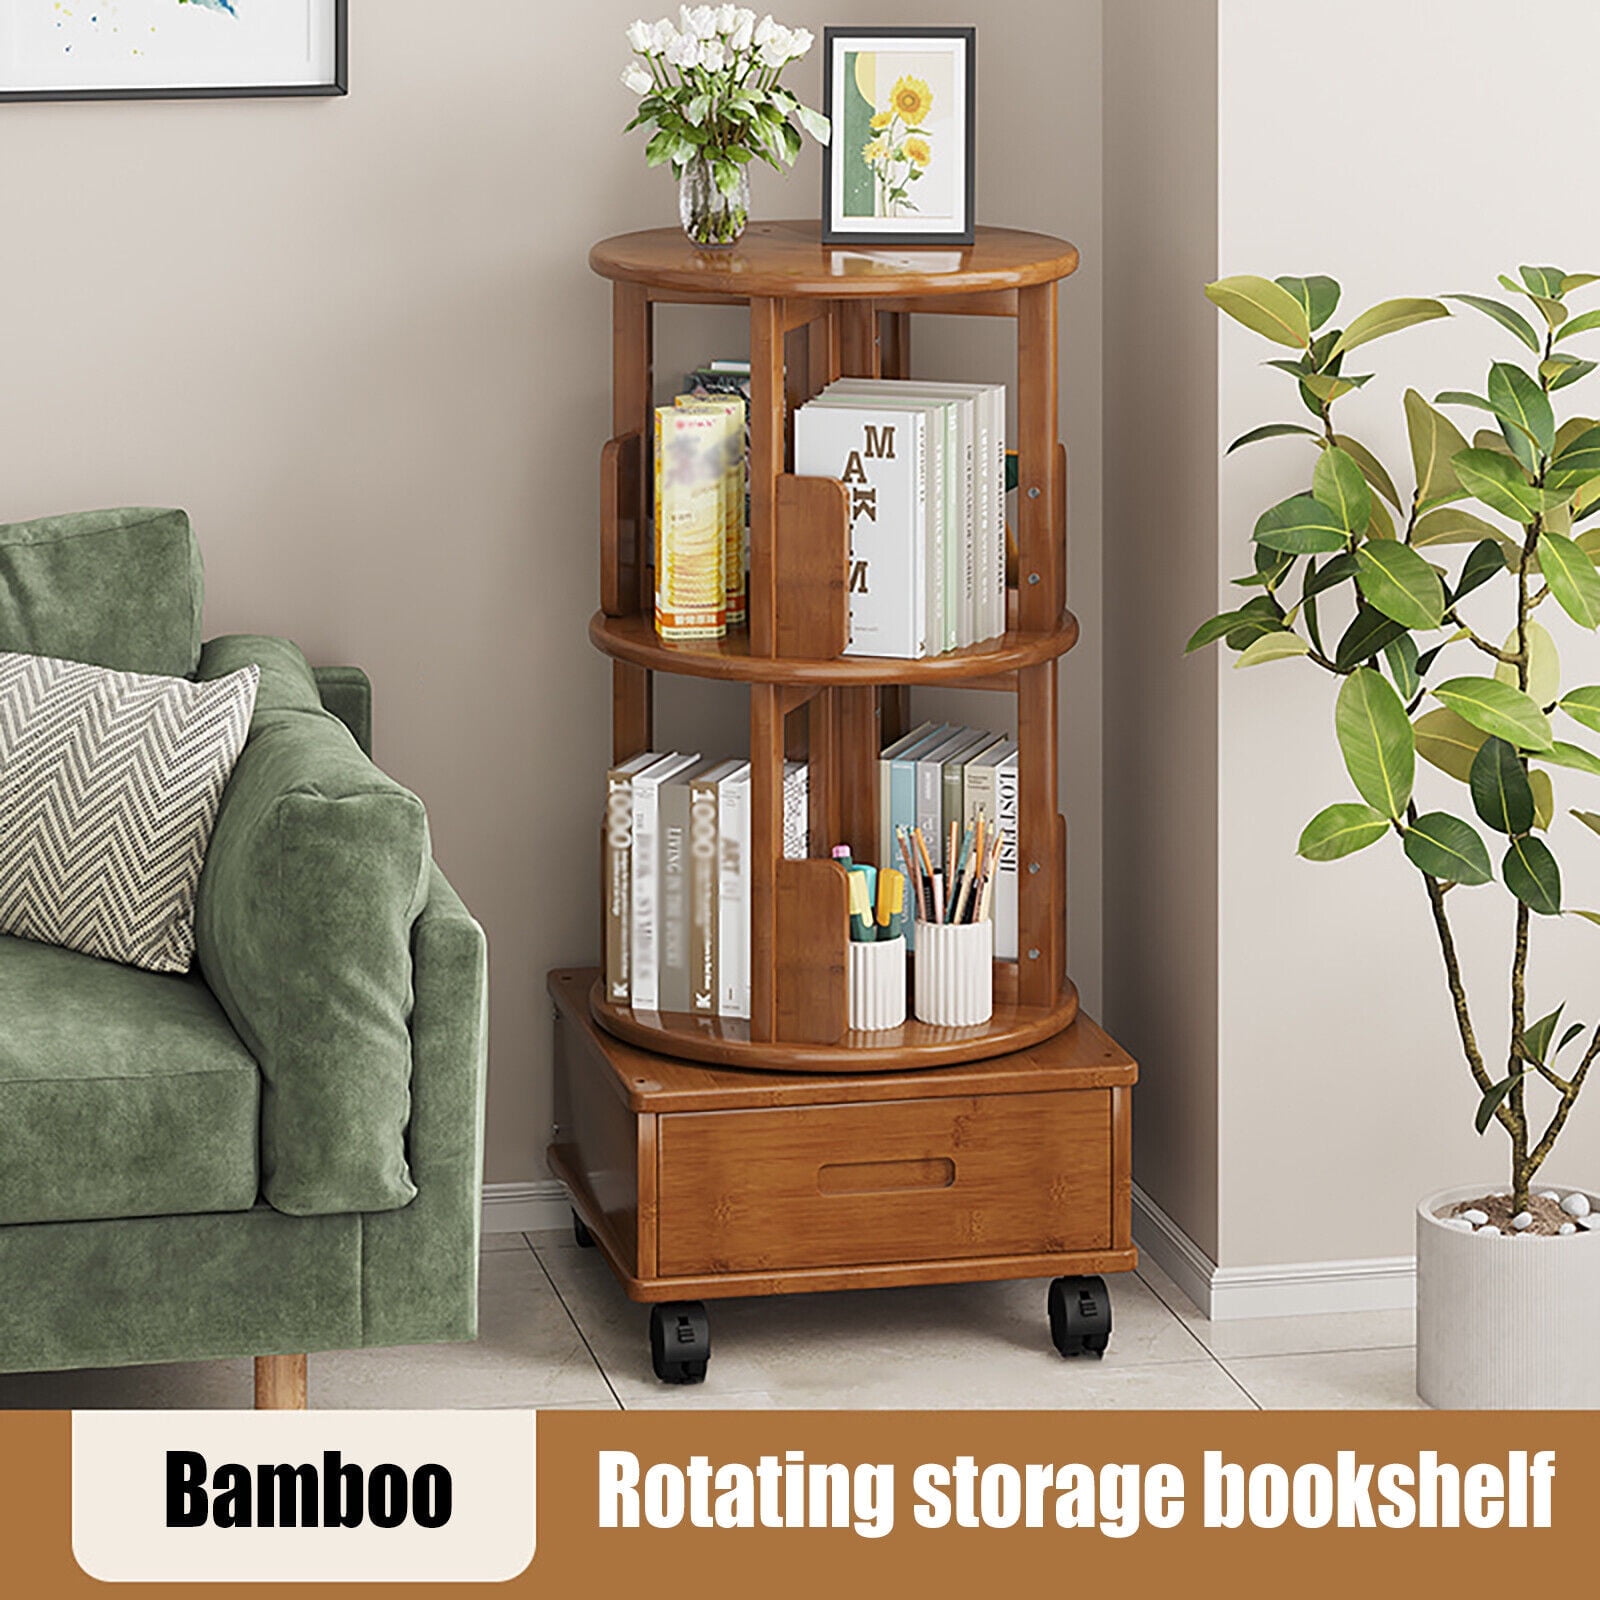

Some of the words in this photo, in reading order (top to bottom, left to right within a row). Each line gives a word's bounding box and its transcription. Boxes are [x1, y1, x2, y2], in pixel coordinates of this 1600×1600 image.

[609, 779, 633, 848] 1000
[691, 788, 716, 857] 1000
[999, 773, 1017, 825] LOST
[665, 826, 683, 874] LIVING
[999, 827, 1017, 873] FISH
